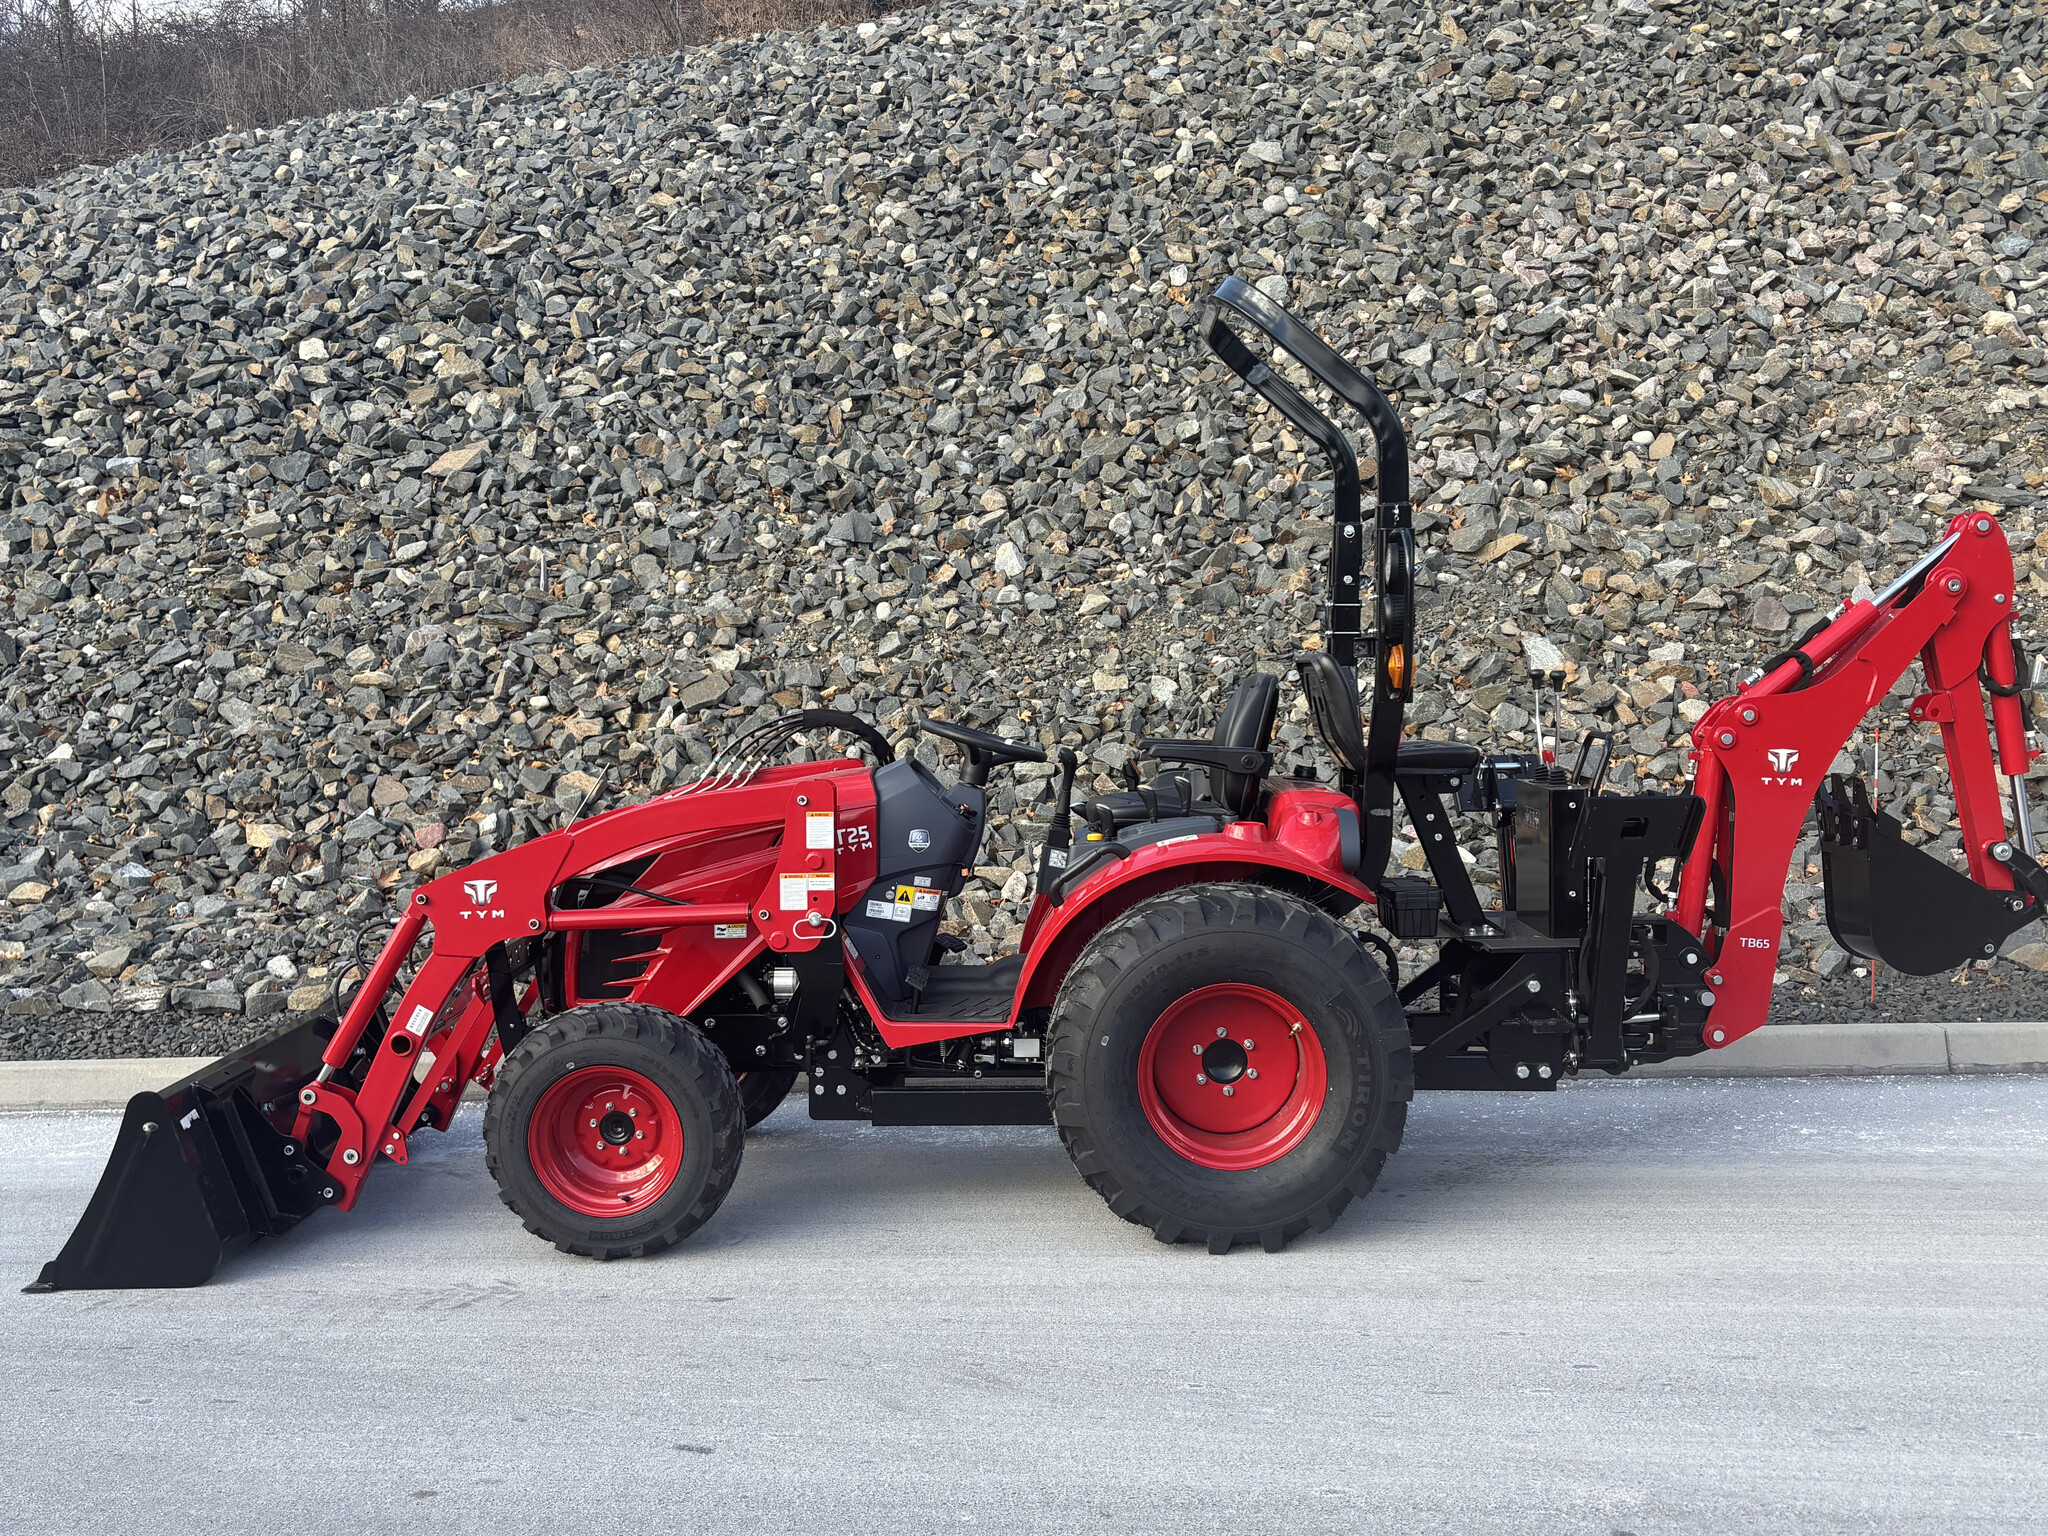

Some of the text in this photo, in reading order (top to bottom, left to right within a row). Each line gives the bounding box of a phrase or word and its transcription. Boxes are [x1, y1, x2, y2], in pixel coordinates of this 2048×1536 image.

[1761, 777, 1803, 786] TYM
[836, 825, 870, 845] T25
[836, 841, 873, 855] TYM
[460, 909, 505, 920] TYM
[1740, 937, 1770, 949] TB65
[1340, 1049, 1371, 1151] TIRON
